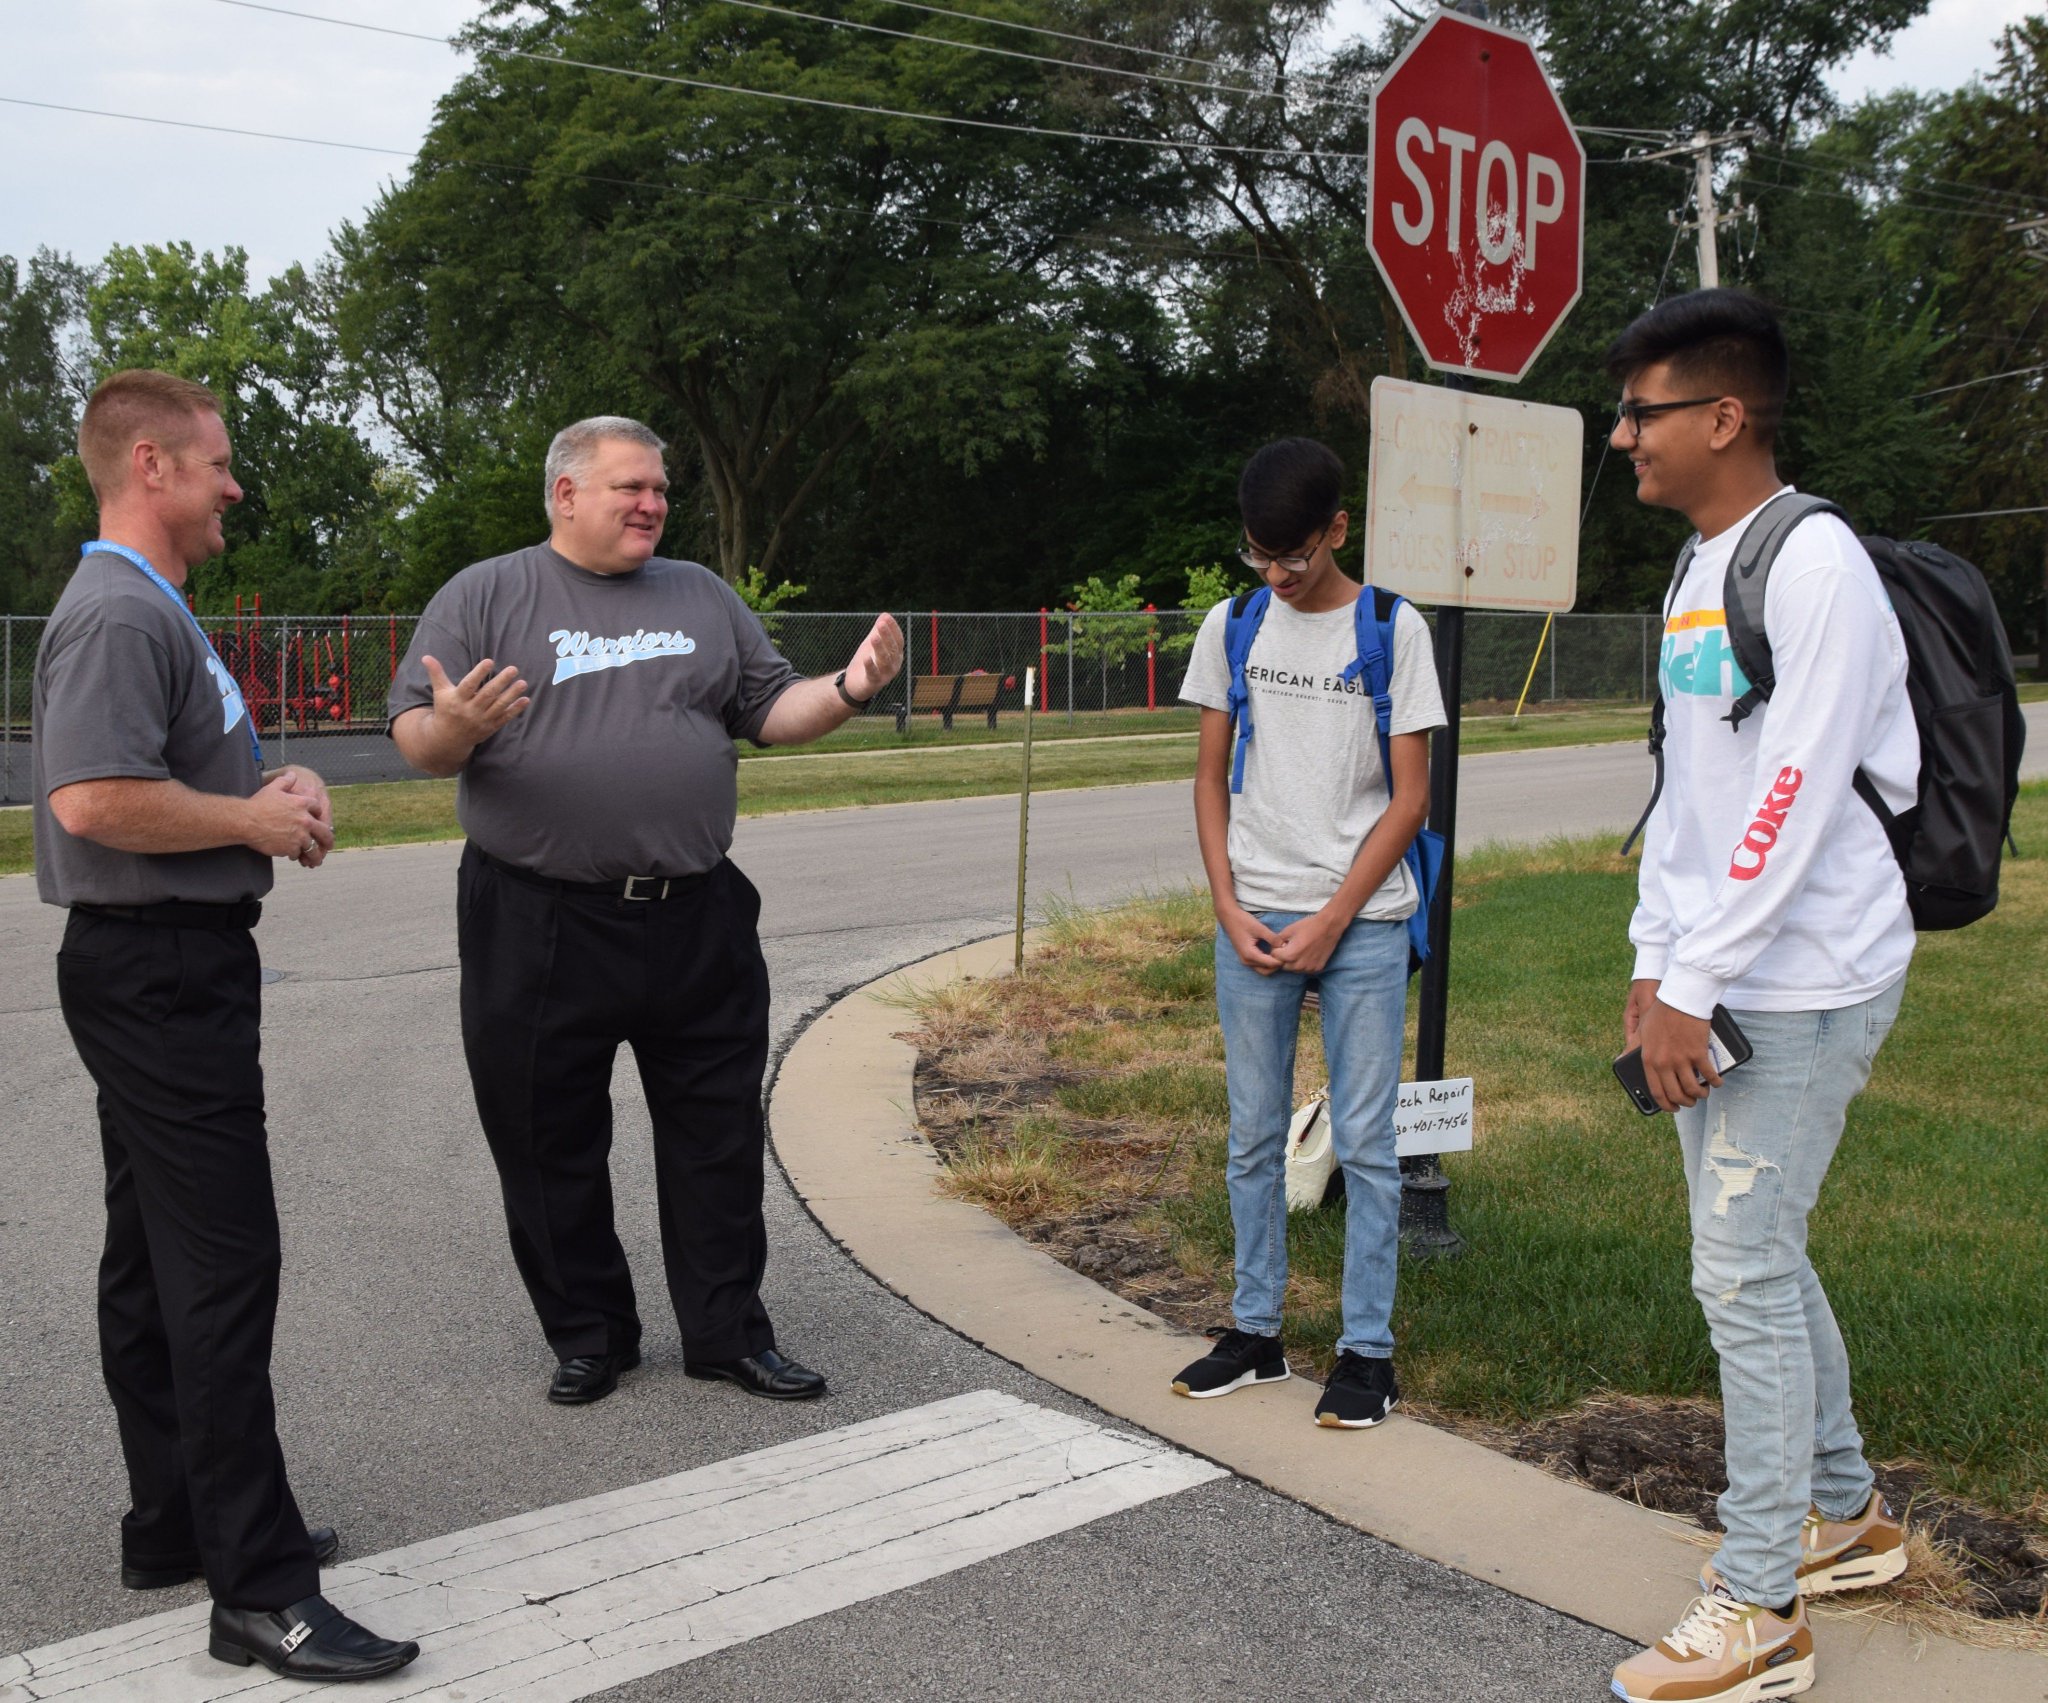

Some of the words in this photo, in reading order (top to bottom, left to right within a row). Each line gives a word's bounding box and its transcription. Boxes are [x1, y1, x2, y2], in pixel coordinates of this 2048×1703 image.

[1391, 117, 1565, 271] STOP
[1503, 542, 1557, 582] STOP
[549, 629, 696, 664] Warriors
[1245, 666, 1314, 688] ERICAN
[1429, 1086, 1469, 1104] Repair
